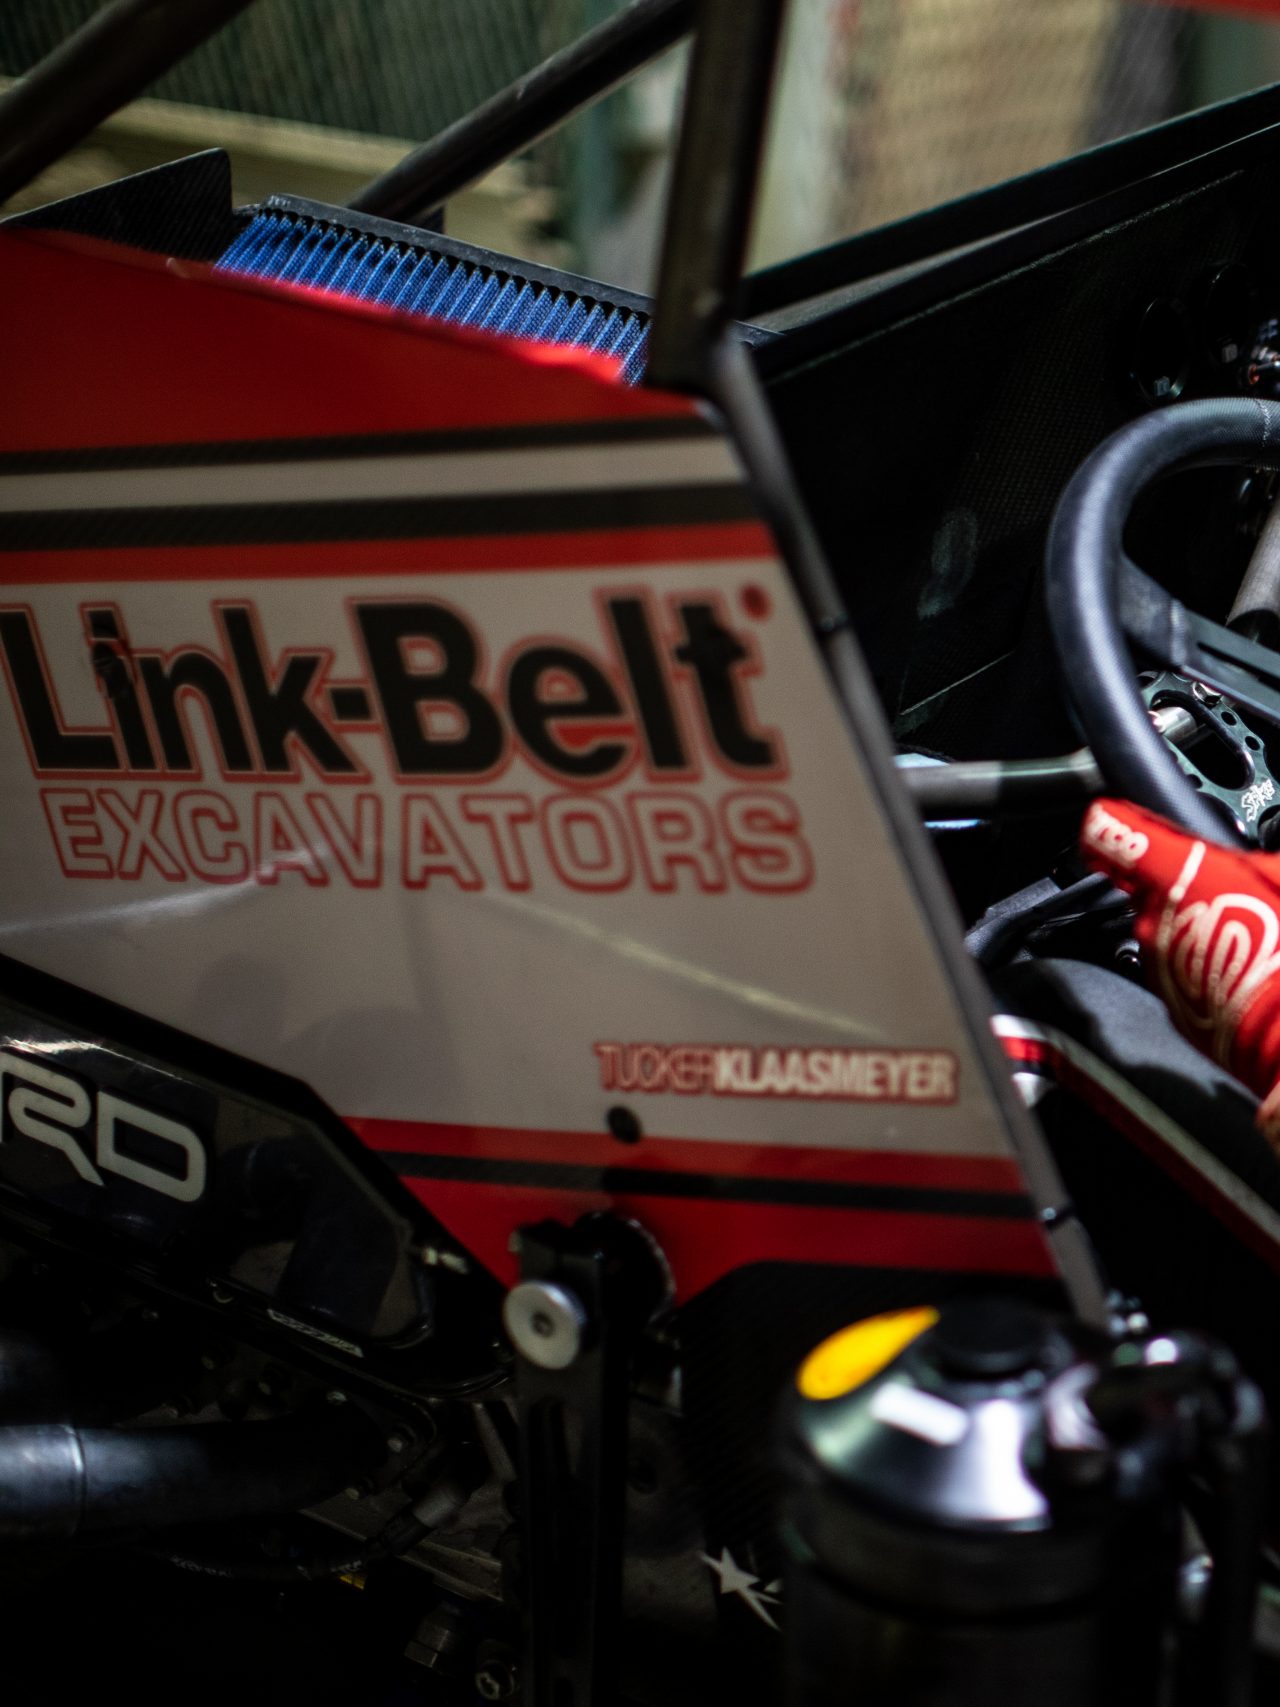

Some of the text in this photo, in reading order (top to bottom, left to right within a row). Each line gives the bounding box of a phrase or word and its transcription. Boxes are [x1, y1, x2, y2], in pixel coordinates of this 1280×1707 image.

[0, 588, 790, 788] Link-Belt
[41, 787, 815, 896] EXCAVATORS
[0, 1051, 207, 1203] RD
